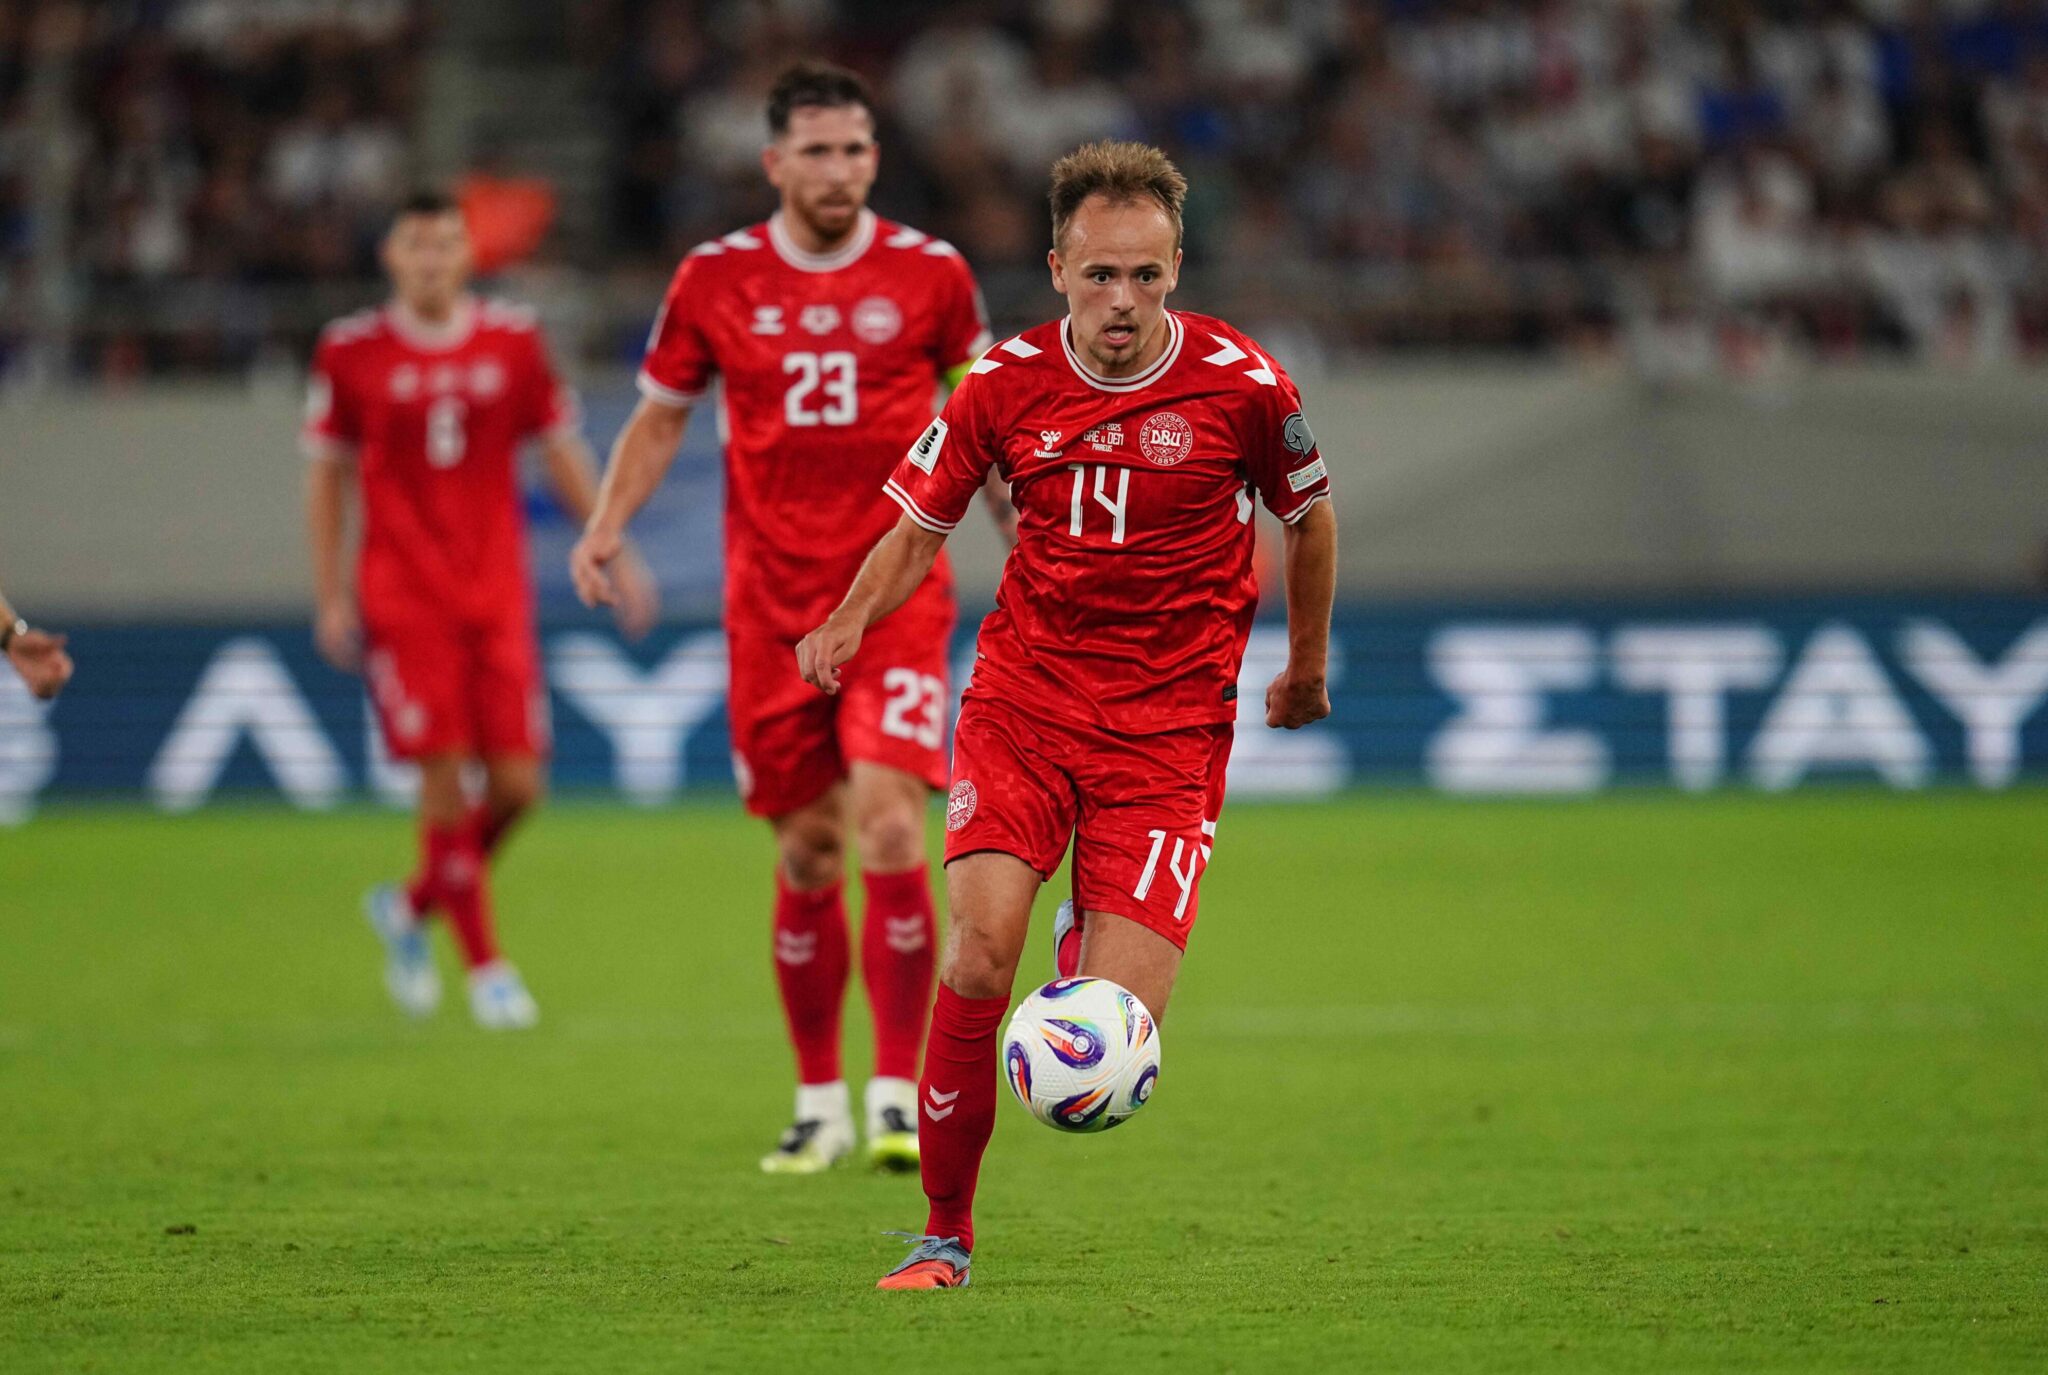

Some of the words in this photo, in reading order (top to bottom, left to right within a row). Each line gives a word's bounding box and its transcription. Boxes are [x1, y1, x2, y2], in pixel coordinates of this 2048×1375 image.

[782, 351, 858, 426] 23
[1107, 431, 1124, 446] DEN
[1150, 429, 1182, 447] DBU
[1153, 456, 1175, 465] 1889
[1068, 464, 1131, 544] 14
[880, 667, 946, 750] 23
[950, 794, 968, 815] DBU
[1133, 828, 1198, 920] 14
